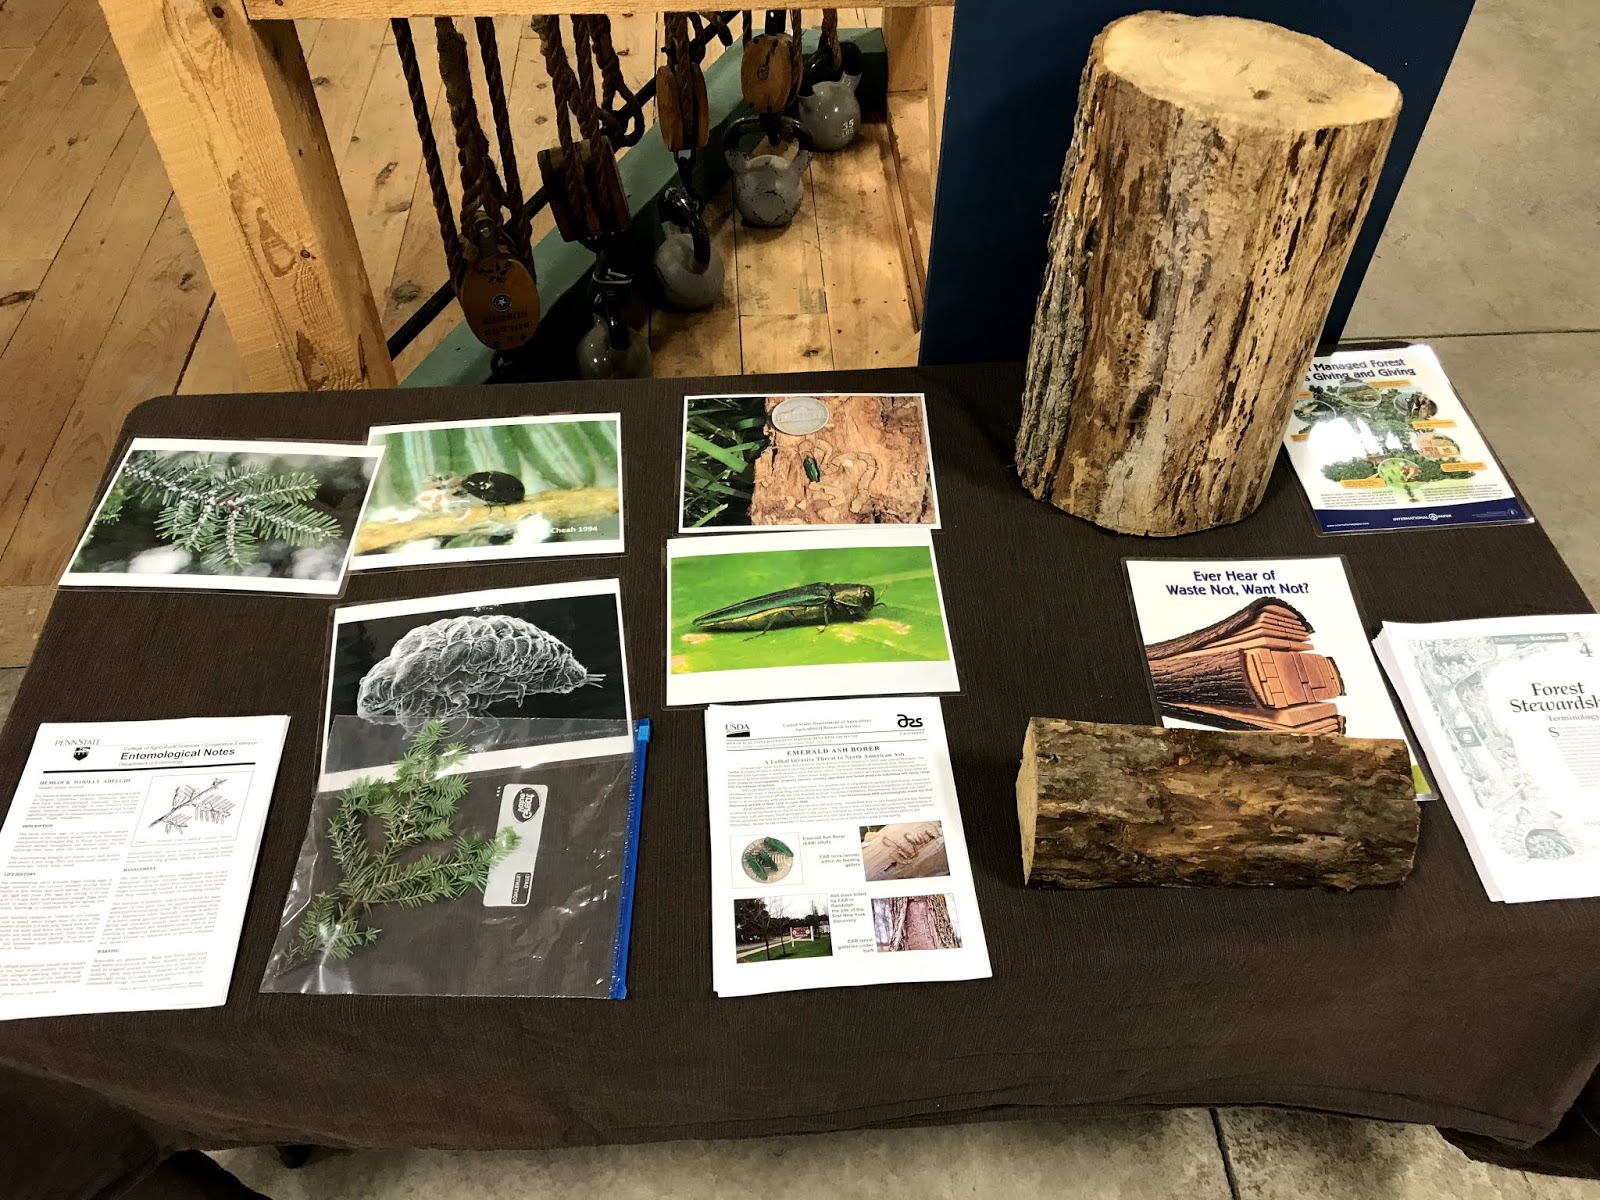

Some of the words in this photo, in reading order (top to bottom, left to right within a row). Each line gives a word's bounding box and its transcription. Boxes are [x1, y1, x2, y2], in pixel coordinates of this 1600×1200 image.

[842, 118, 854, 130] 35
[1313, 361, 1367, 372] Managed
[1370, 358, 1406, 368] Forest
[1313, 371, 1350, 381] Giving
[1354, 370, 1375, 379] and
[1378, 367, 1417, 377] Giving
[551, 526, 576, 534] Cheah
[1193, 571, 1221, 582] Ever
[1225, 570, 1258, 581] Hear
[1262, 569, 1276, 581] of
[1166, 584, 1206, 595] Waste
[1210, 584, 1240, 596] Not,
[1241, 583, 1277, 595] Want
[1279, 582, 1309, 594] Not?
[1580, 642, 1594, 658] 4
[1529, 681, 1586, 697] Forest
[1546, 713, 1600, 722] Terminology
[725, 723, 750, 731] USDA
[120, 749, 201, 761] Entomological
[203, 747, 236, 757] Notes
[851, 745, 880, 753] BORER
